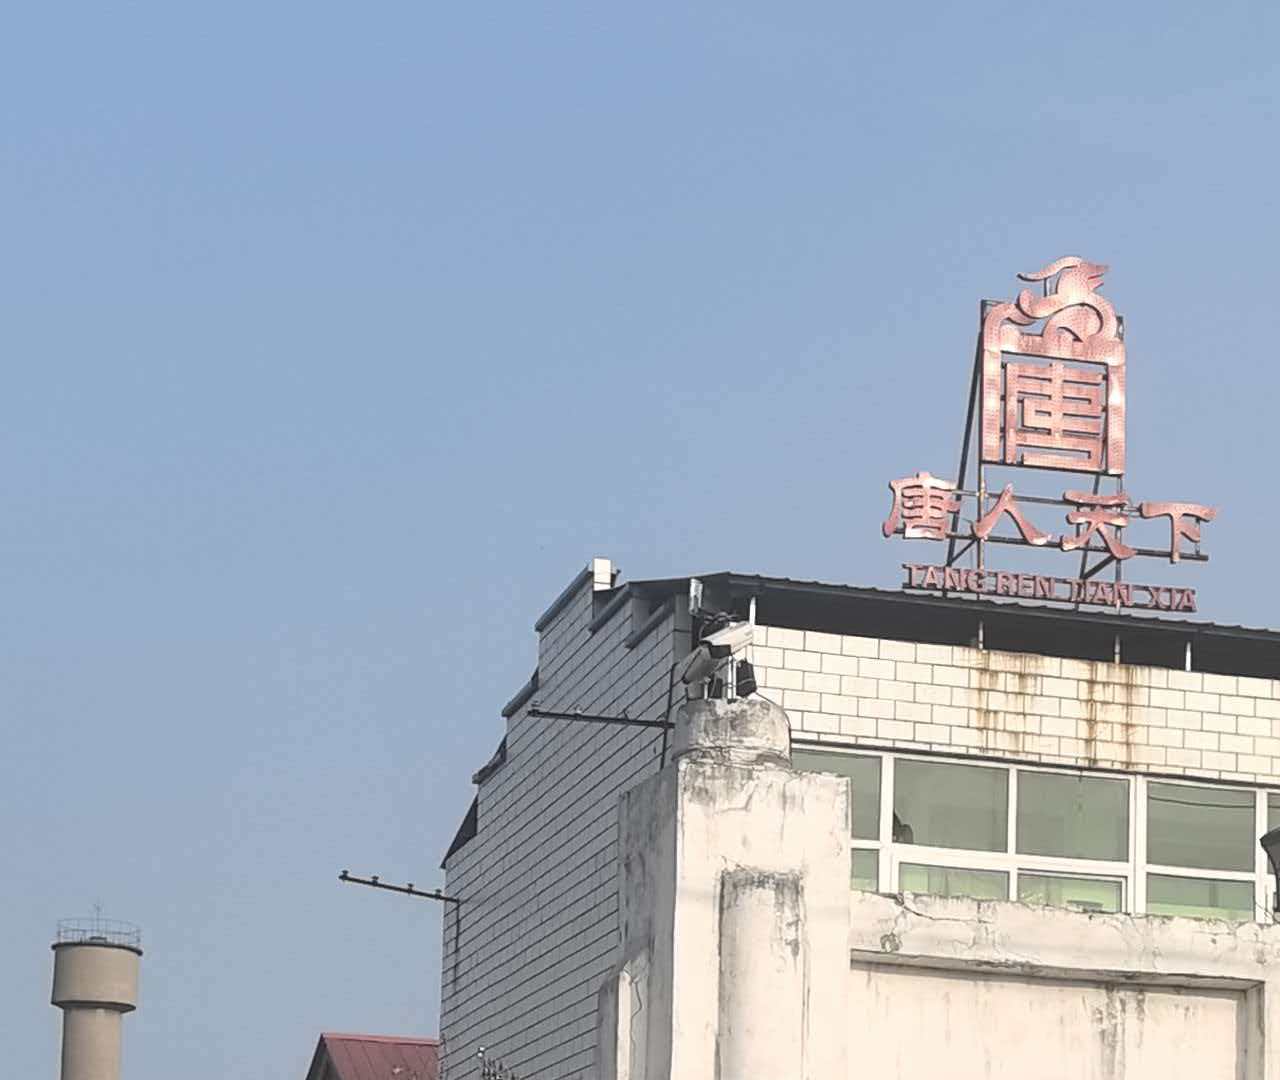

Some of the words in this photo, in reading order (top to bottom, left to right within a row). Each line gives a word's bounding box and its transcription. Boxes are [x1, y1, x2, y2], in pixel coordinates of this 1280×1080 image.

[882, 471, 1217, 565] 唐人天下
[903, 564, 988, 593] TANG
[995, 571, 1057, 598] REN
[1067, 577, 1134, 608] TIAN
[1146, 585, 1198, 612] XIA
